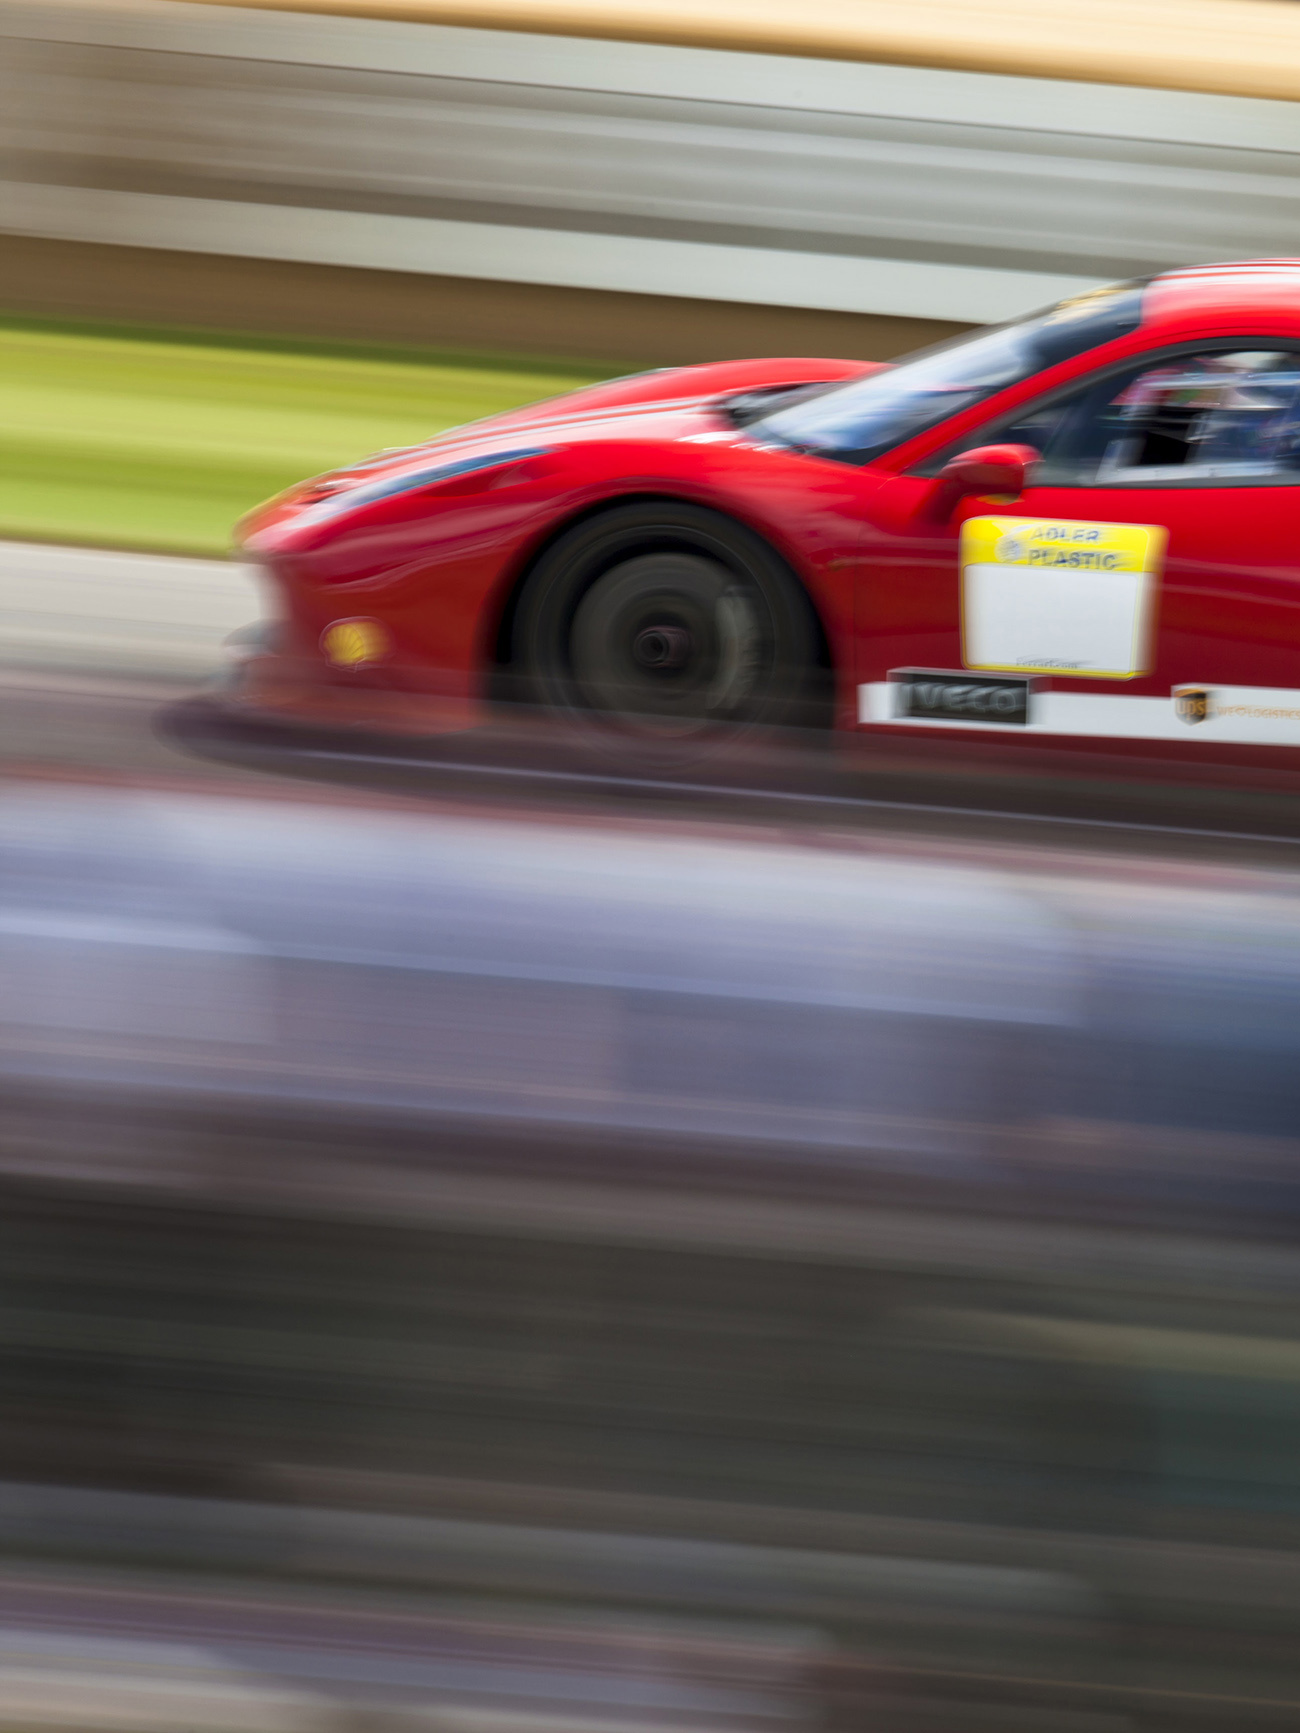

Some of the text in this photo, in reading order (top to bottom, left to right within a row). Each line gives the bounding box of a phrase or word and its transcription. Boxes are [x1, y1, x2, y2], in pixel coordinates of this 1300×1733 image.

[1028, 525, 1102, 543] ADLER
[1026, 548, 1118, 571] PLASTIC
[899, 681, 1020, 714] IVECO
